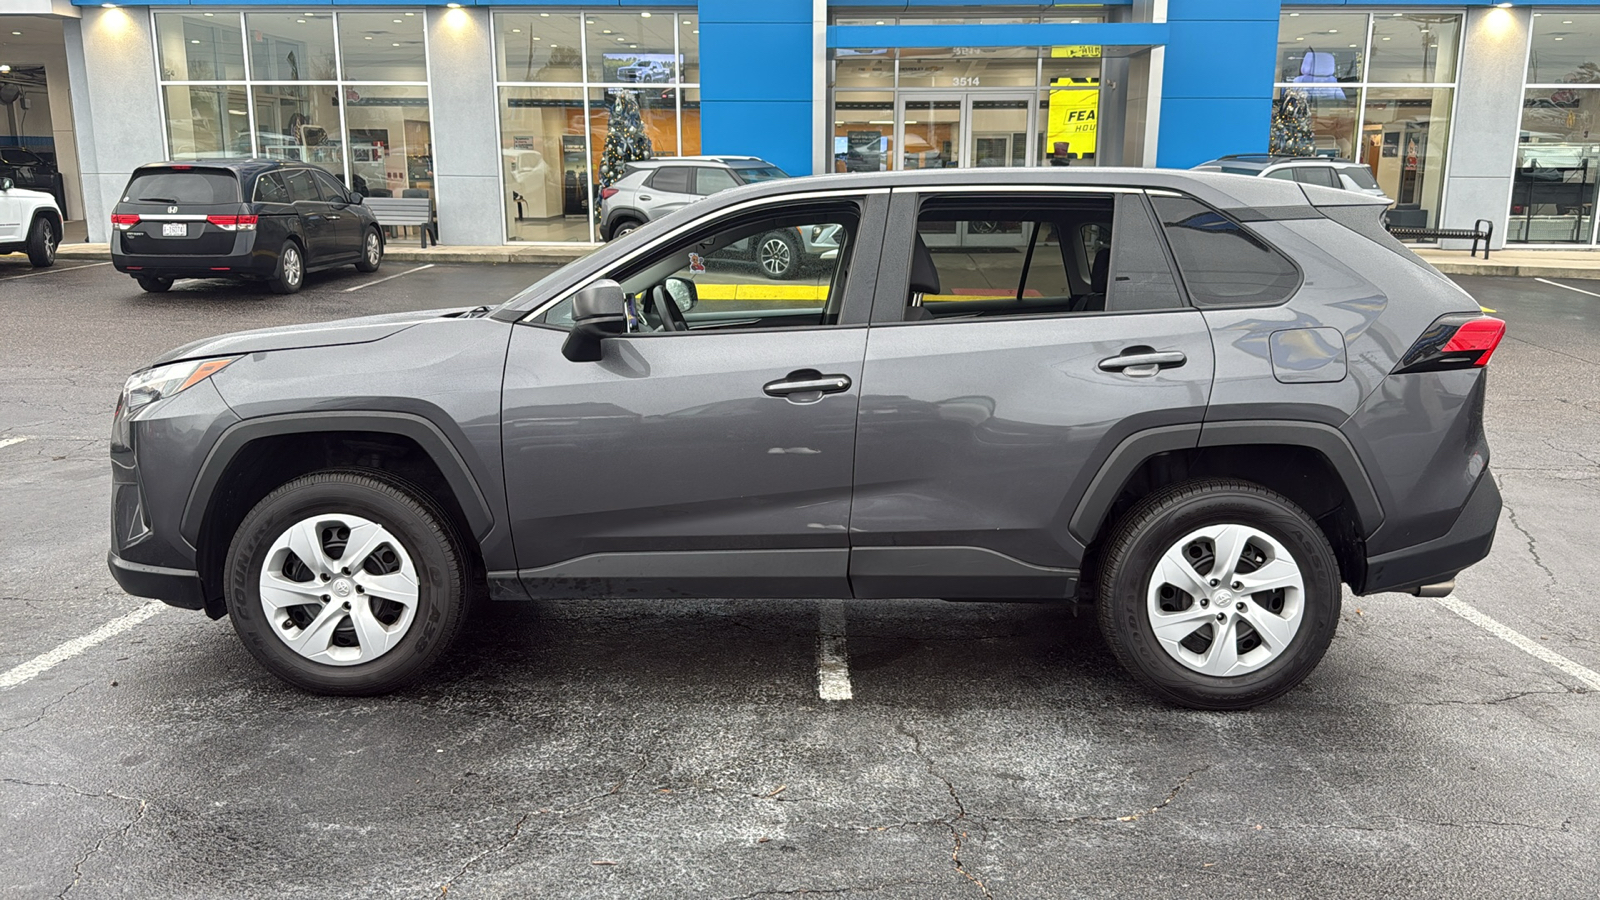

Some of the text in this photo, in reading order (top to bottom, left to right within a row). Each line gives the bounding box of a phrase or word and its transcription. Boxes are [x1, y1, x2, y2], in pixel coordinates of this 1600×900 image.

[952, 76, 980, 87] 3514
[1068, 109, 1095, 122] FEA
[1075, 124, 1096, 133] HOU
[234, 509, 279, 621] COUNTRY
[414, 602, 442, 655] A38
